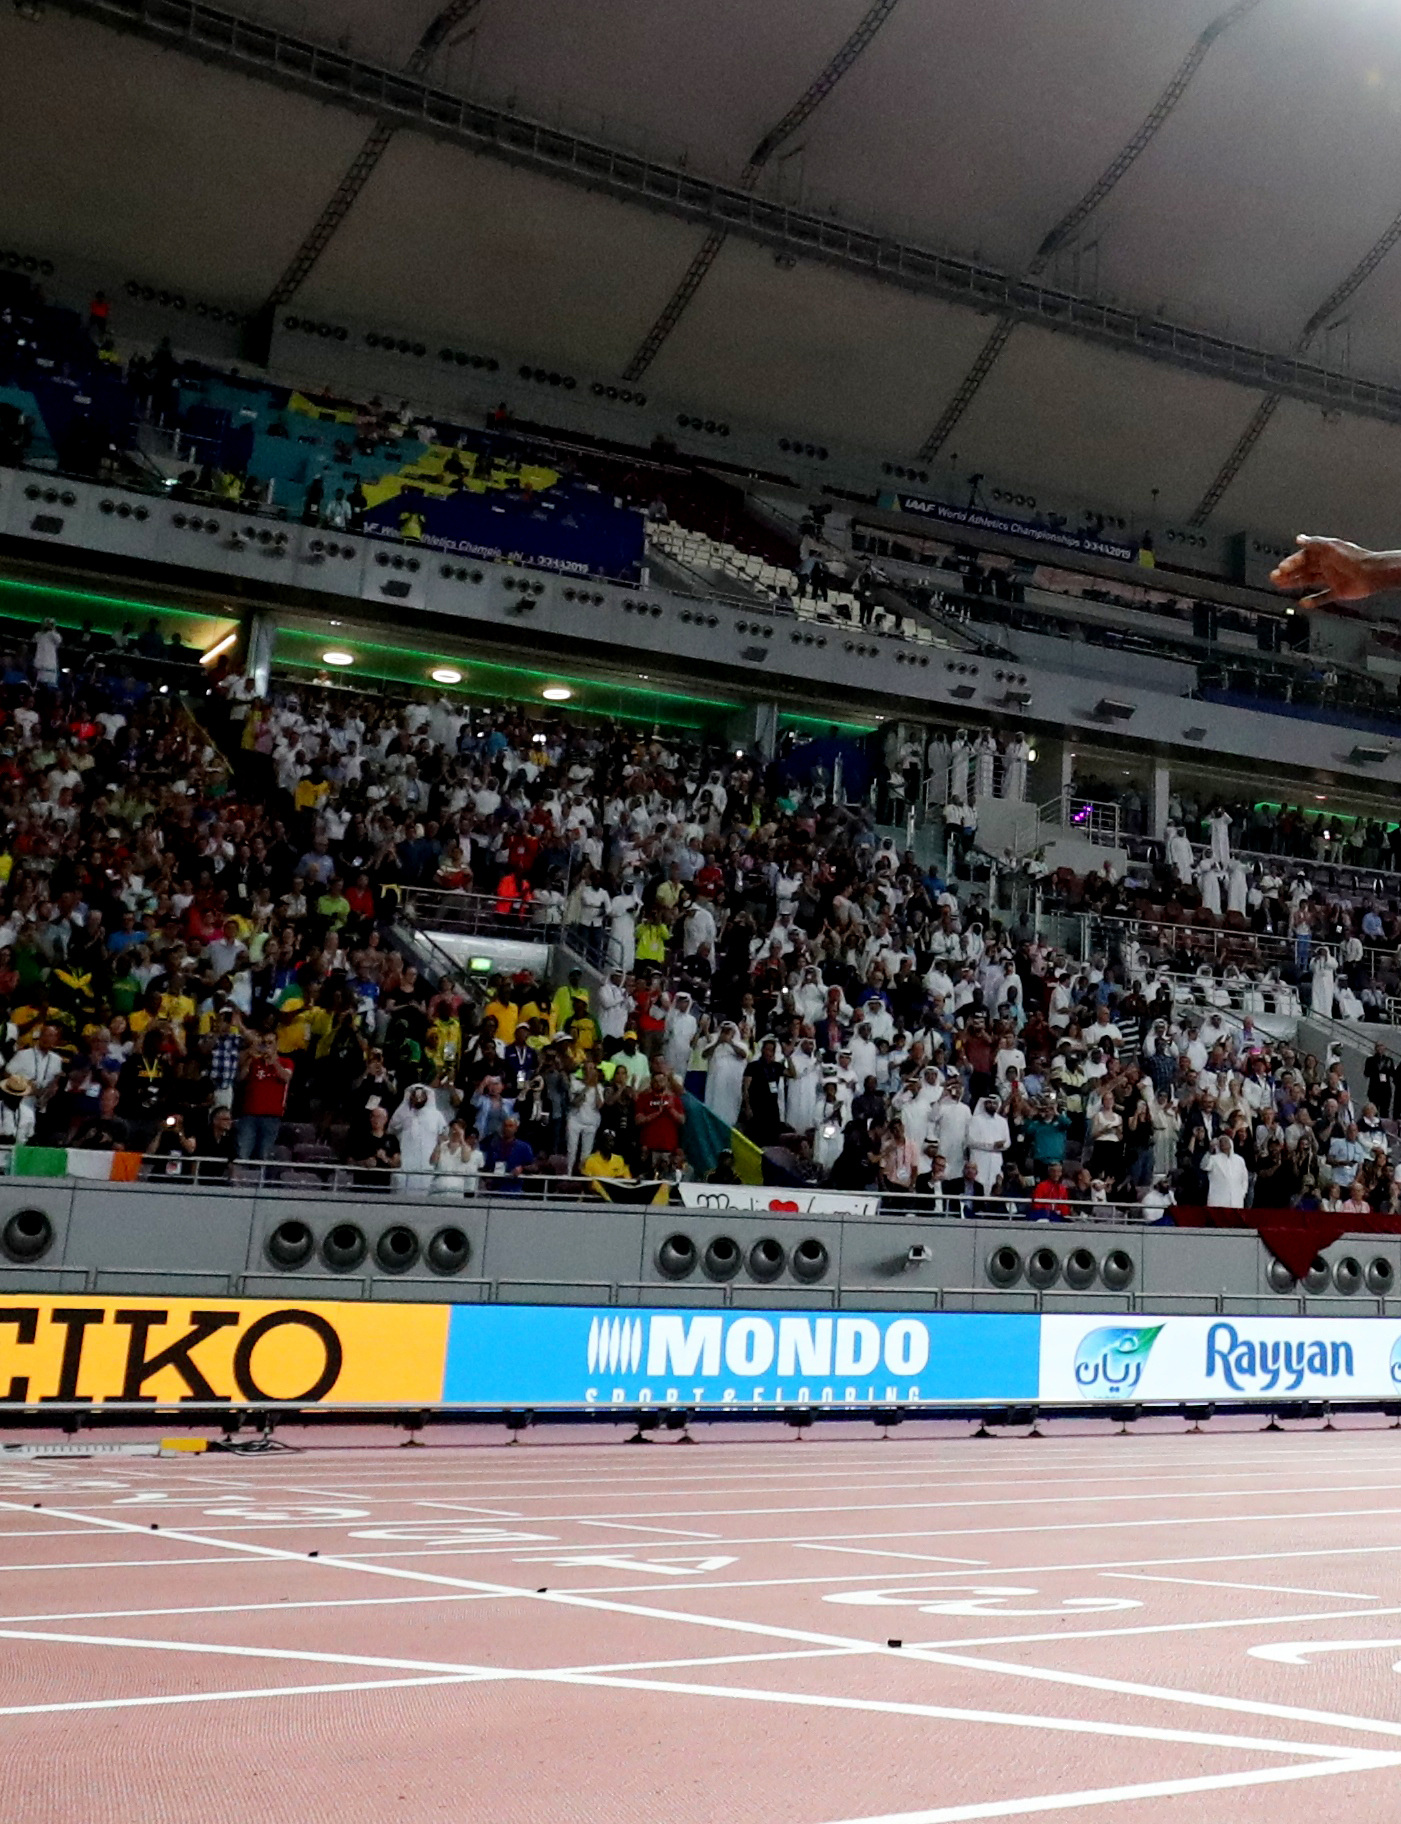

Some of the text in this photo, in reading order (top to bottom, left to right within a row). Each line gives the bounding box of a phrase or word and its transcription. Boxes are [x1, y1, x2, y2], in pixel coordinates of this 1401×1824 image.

[905, 498, 936, 513] IAAF
[937, 506, 967, 522] World
[968, 514, 1009, 532] Athletics
[1010, 522, 1080, 548] Championships
[646, 1316, 930, 1377] MONDO
[1205, 1322, 1354, 1391] Rayyan
[346, 1527, 562, 1546] 5
[512, 1554, 740, 1576] 4
[820, 1585, 1145, 1617] 3
